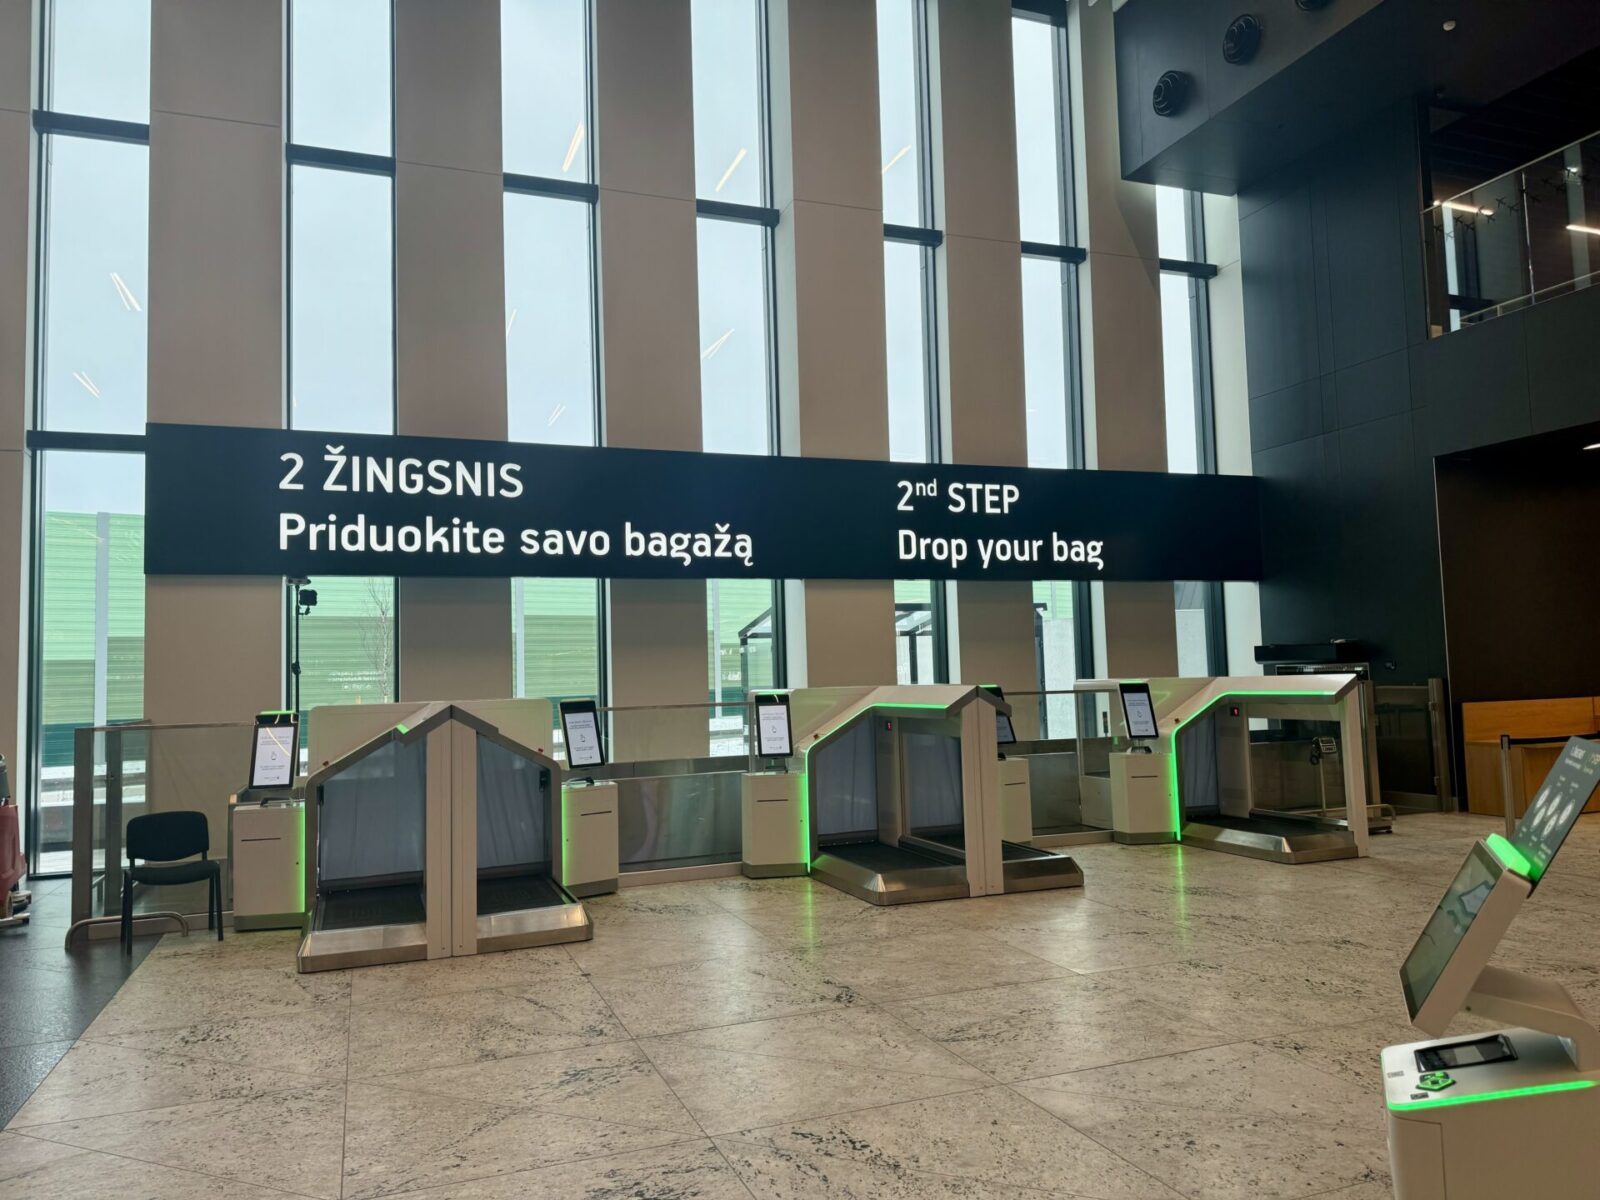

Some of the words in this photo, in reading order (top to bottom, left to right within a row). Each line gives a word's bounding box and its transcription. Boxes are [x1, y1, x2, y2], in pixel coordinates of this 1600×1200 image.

[278, 453, 304, 490] 2
[322, 445, 524, 499] ŽINGSNIS
[896, 478, 938, 511] 2nd
[947, 483, 1020, 514] STEP
[279, 512, 505, 554] Priduokite
[520, 528, 610, 557] savo
[624, 522, 754, 567] bagažą
[898, 529, 968, 569] Drop
[977, 538, 1044, 569] your
[1052, 531, 1104, 571] bag
